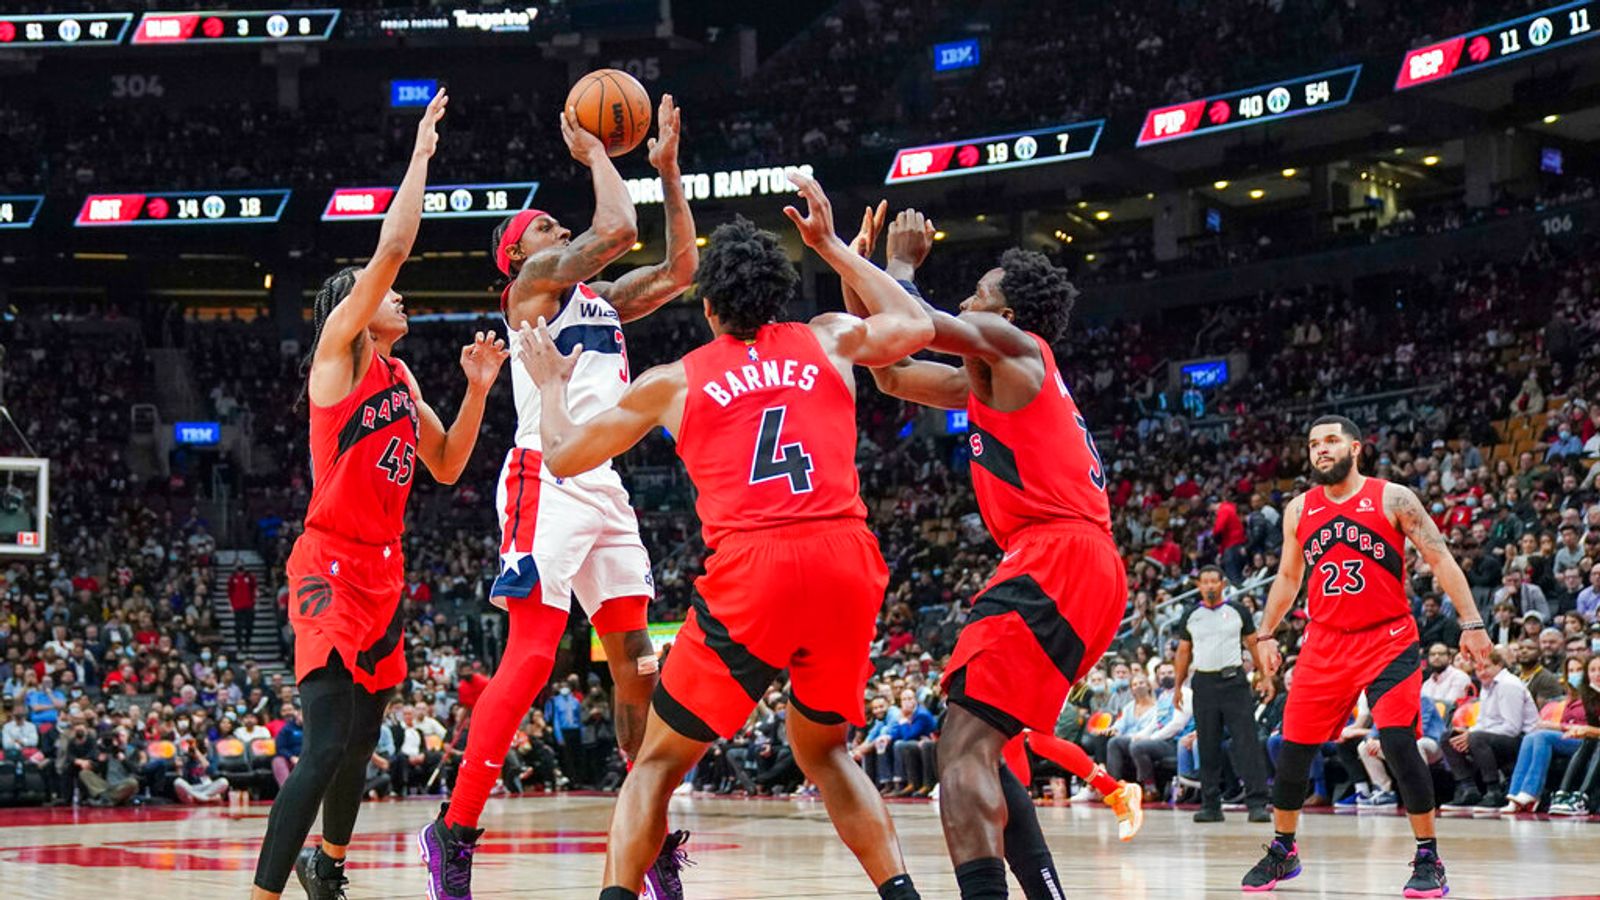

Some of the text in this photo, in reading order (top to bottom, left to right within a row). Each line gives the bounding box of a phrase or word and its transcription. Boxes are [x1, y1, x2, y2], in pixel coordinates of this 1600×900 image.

[89, 22, 108, 39] 47
[453, 9, 529, 31] Tangerine
[1500, 29, 1520, 55] 11
[1569, 8, 1591, 35] 11
[941, 45, 973, 65] IBM
[111, 74, 165, 97] 304
[398, 85, 431, 102] IBM
[1239, 95, 1263, 118] 40
[1305, 80, 1330, 106] 54
[986, 142, 1009, 164] 19
[1057, 133, 1069, 154] 7
[177, 199, 199, 218] 14
[424, 192, 447, 212] 20
[1541, 213, 1573, 236] 106
[702, 358, 820, 408] BARNES
[181, 427, 213, 443] IBM
[375, 435, 416, 486] 45
[748, 404, 815, 495] 4
[1304, 521, 1385, 566] RAPTORS
[1318, 559, 1366, 597] 23
